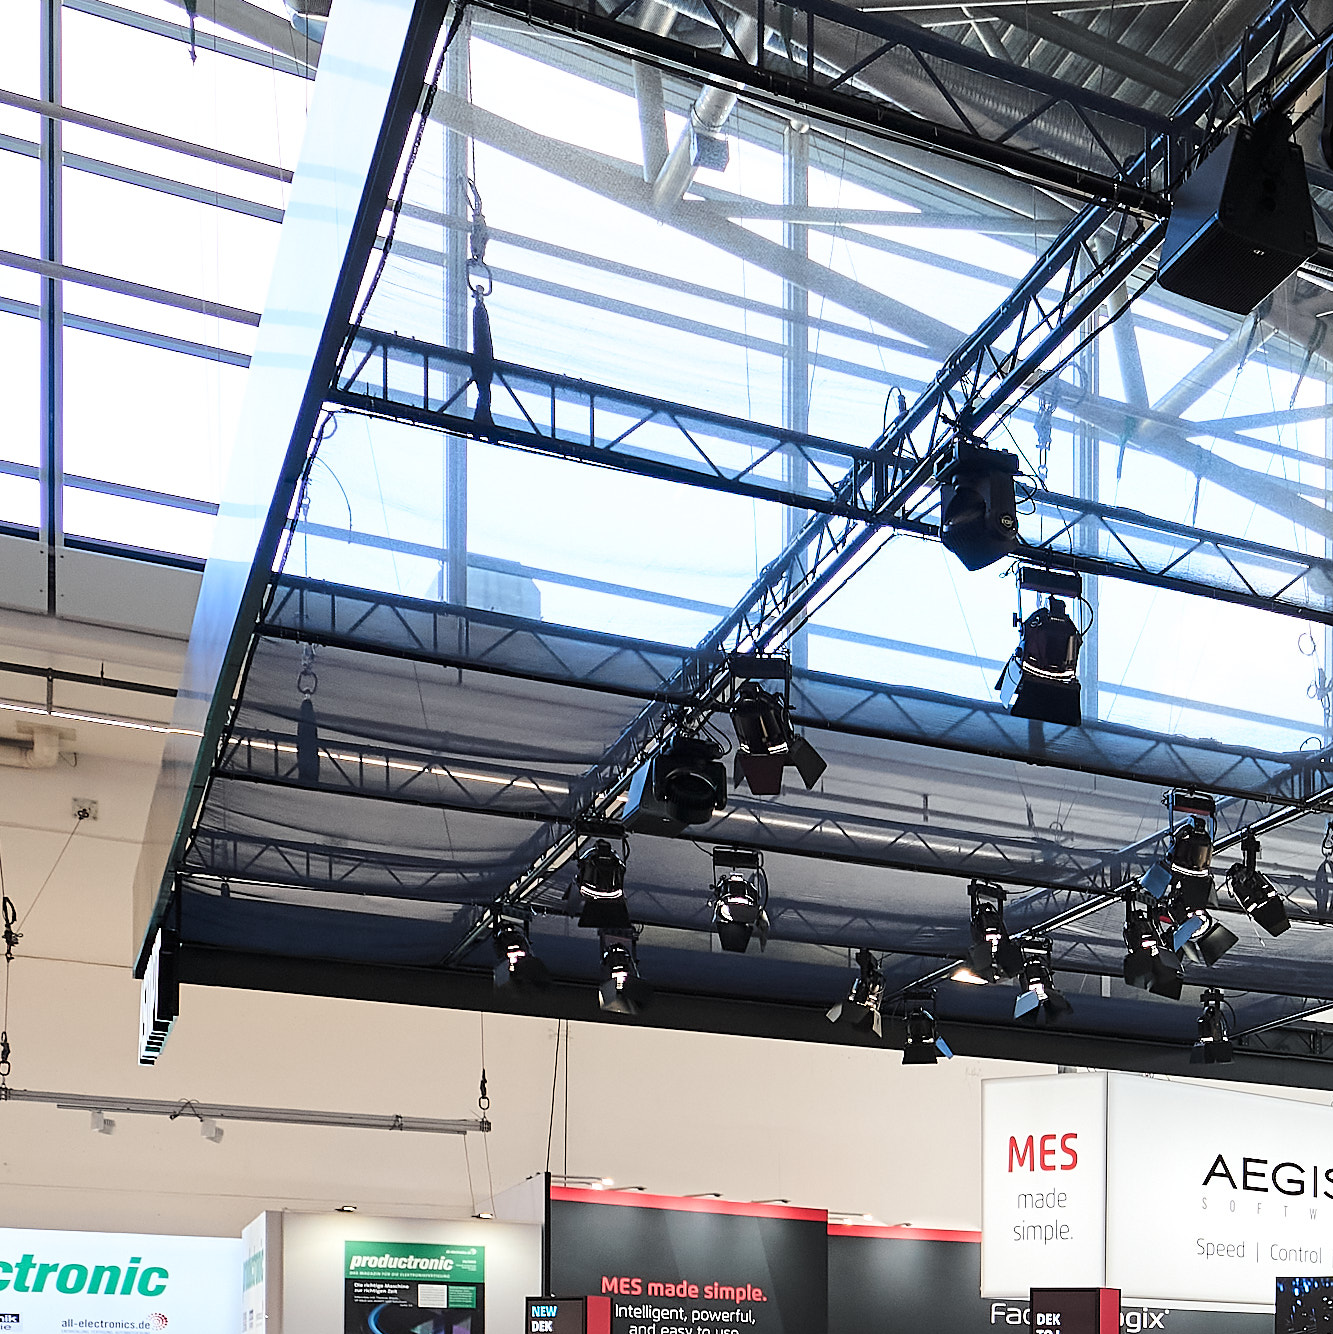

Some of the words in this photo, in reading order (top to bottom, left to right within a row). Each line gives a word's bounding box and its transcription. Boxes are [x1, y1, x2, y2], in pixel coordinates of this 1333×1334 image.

[1007, 1132, 1078, 1173] MES
[1016, 1187, 1068, 1209] made
[1013, 1218, 1074, 1246] simple.
[349, 1253, 454, 1271] productronic
[1196, 1238, 1246, 1260] Speed
[1270, 1243, 1323, 1265] Control
[602, 1276, 643, 1296] MES
[647, 1279, 699, 1299] made
[703, 1282, 768, 1304] simple.
[531, 1305, 558, 1318] NEW
[615, 1304, 688, 1322] Intelligent,
[691, 1308, 756, 1325] powerful,
[1036, 1312, 1061, 1326] DEK
[61, 1318, 151, 1330] all-electronics.de
[531, 1320, 553, 1333] DEK
